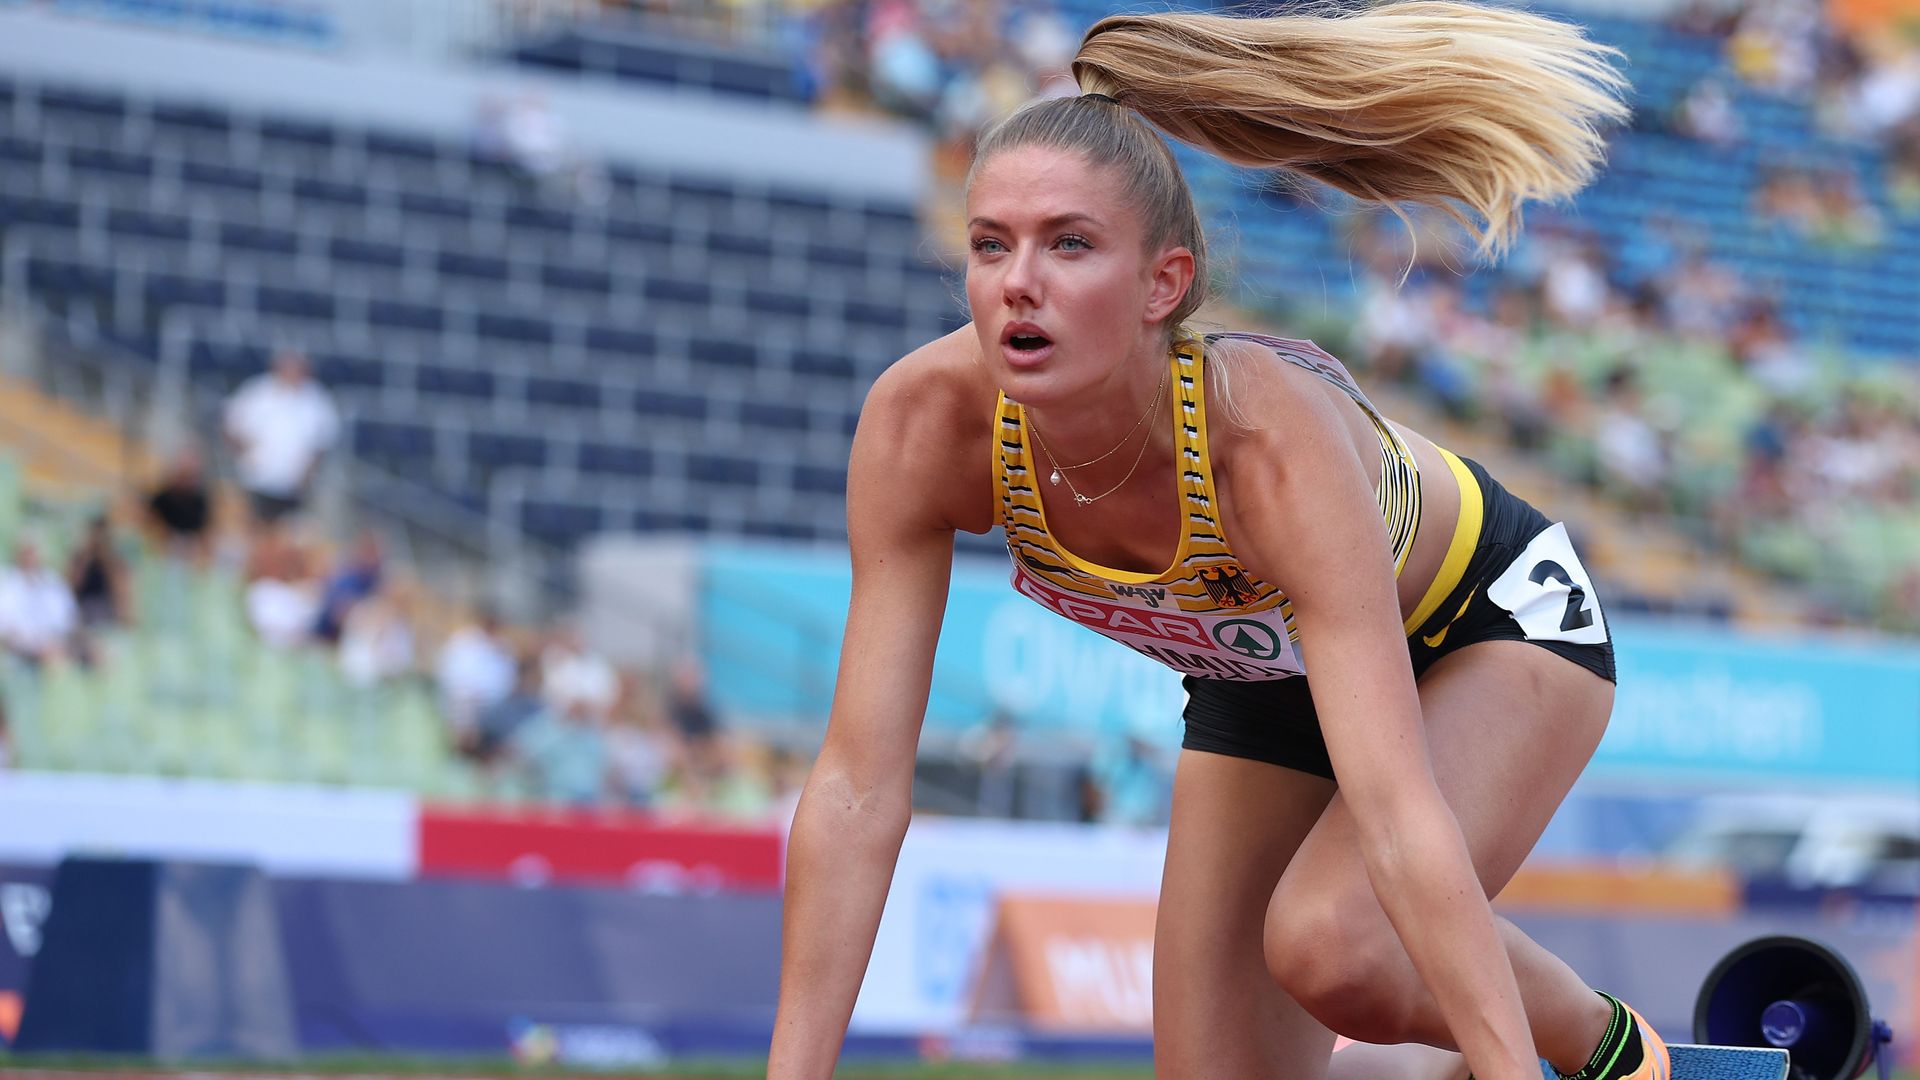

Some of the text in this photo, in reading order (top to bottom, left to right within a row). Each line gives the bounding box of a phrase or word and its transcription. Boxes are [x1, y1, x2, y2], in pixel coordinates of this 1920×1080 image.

[1020, 576, 1208, 646] SPAR
[1110, 583, 1166, 609] wgv
[1528, 559, 1594, 632] 2
